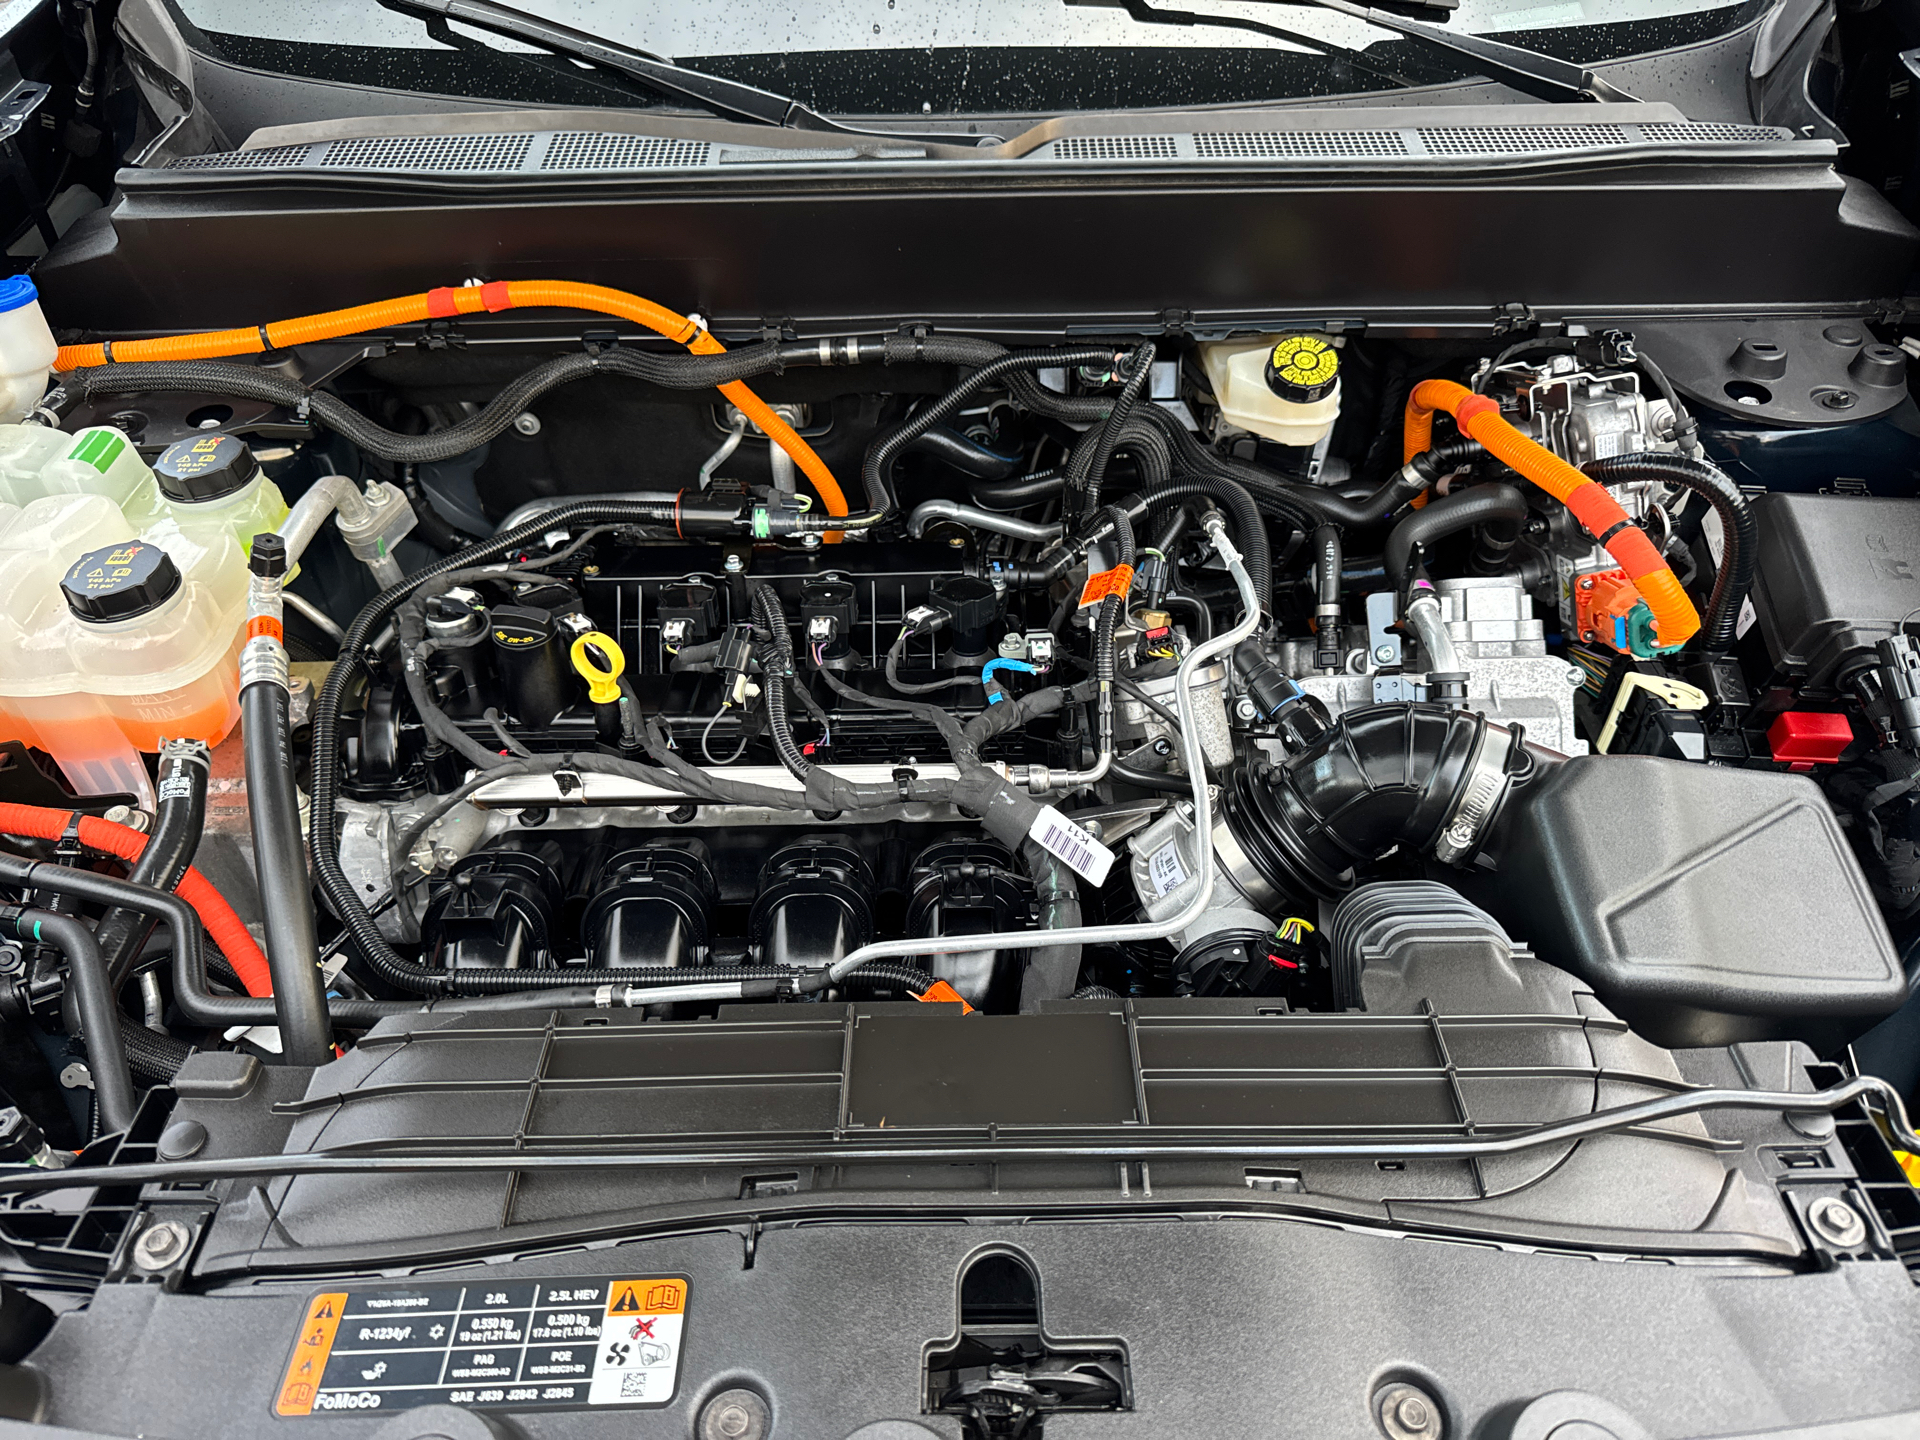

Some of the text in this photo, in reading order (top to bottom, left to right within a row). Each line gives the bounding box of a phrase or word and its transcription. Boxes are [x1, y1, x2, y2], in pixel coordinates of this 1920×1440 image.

[137, 706, 176, 720] MIN
[1067, 825, 1090, 846] K11
[484, 1292, 509, 1304] 2.0L
[548, 1289, 600, 1302] 2.5L HEV
[471, 1317, 514, 1330] 0.550 kg
[547, 1314, 590, 1328] 0.500 kg
[358, 1326, 412, 1341] R-1234yf
[473, 1354, 496, 1366] PAG
[551, 1350, 574, 1362] POE
[314, 1392, 382, 1410] FoMoCo
[450, 1390, 475, 1402] SAE
